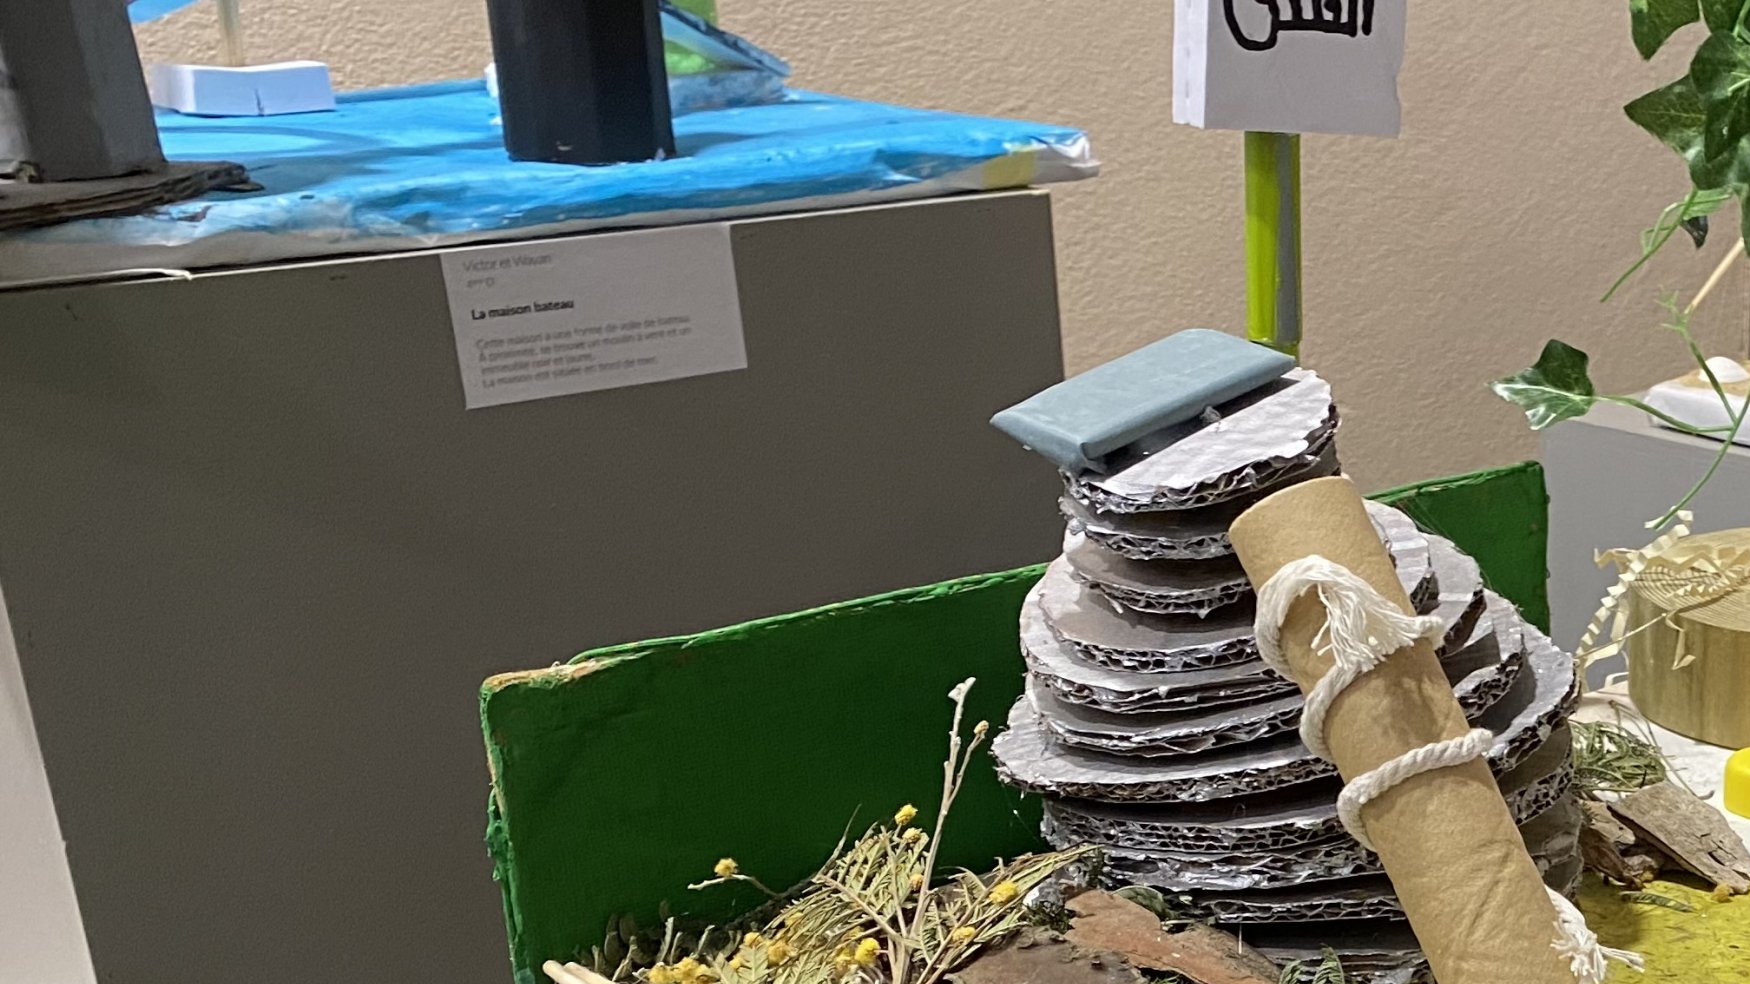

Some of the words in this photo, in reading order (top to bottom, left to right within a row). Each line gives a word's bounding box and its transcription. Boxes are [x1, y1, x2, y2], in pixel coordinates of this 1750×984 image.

[471, 309, 486, 320] La
[488, 304, 532, 318] maison
[533, 300, 574, 313] bateau
